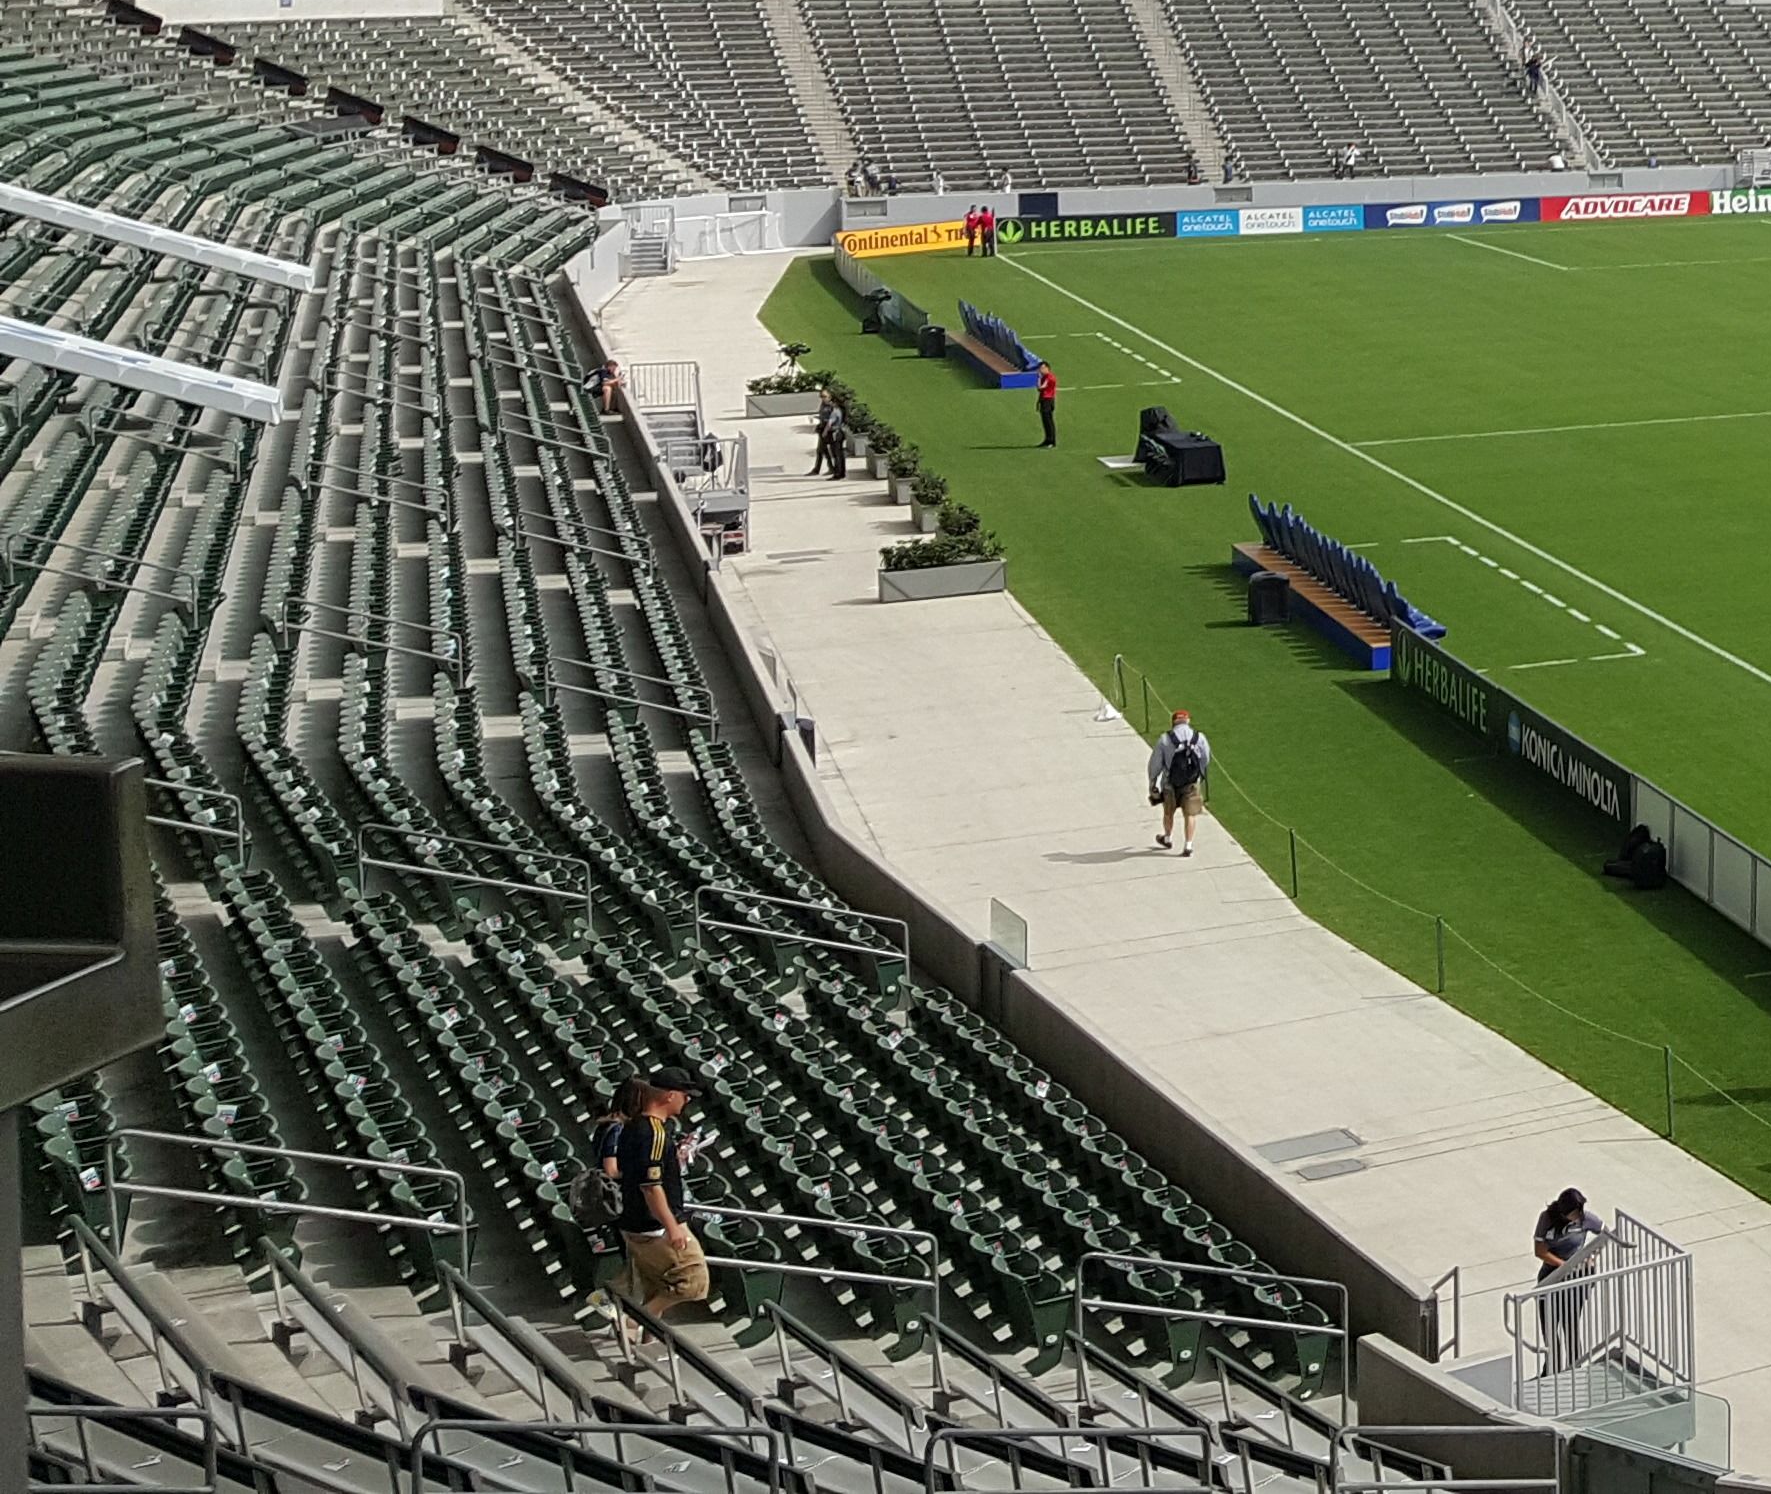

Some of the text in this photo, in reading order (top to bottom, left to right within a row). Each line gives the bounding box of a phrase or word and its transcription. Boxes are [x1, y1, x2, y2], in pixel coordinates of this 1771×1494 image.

[1309, 209, 1355, 218] ALCATEL
[1563, 196, 1688, 218] ADVOCARE
[1182, 214, 1232, 223] ALCATEL
[1246, 212, 1294, 221] ALCATEL
[1308, 216, 1357, 227] onetouch
[1030, 217, 1161, 239] HERBALIFE
[1182, 221, 1233, 232] onetouch
[842, 228, 927, 255] Continental
[1413, 646, 1488, 734] HERBALIFE
[1521, 723, 1621, 821] KONICA MINOLTA
